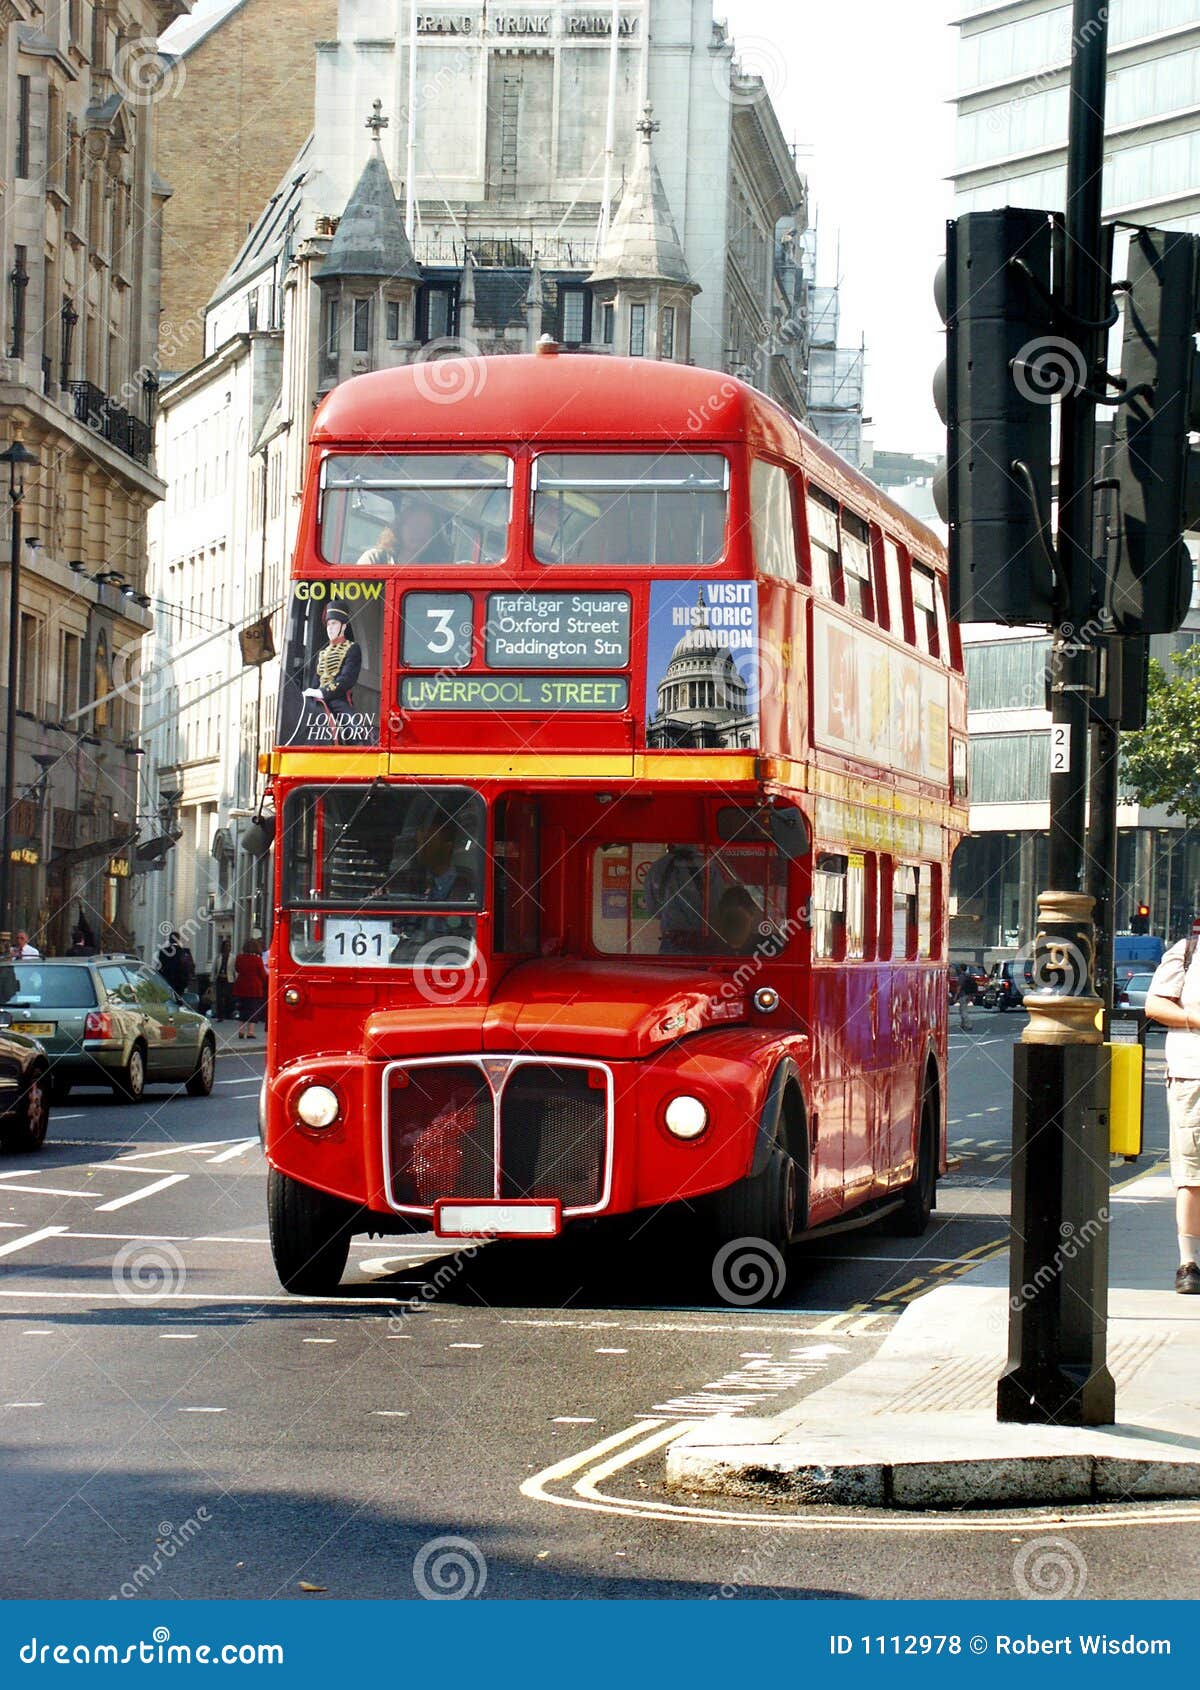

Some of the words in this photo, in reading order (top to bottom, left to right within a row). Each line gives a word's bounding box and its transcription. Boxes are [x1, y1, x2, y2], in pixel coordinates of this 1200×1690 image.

[494, 16, 551, 33] TRUNK
[568, 16, 638, 34] RAILWAY
[294, 582, 325, 600] GO
[330, 582, 383, 600] NOW
[707, 584, 752, 604] VISIT
[494, 597, 564, 617] Trafalgar
[571, 597, 629, 617] Square
[672, 606, 753, 626] HISTORIC
[427, 609, 456, 654] 3
[500, 618, 560, 633] Oxford
[567, 618, 620, 633] Street
[684, 629, 753, 648] LONDON
[495, 639, 587, 659] Paddington
[594, 640, 622, 655] Stn
[407, 682, 531, 702] LIVERPOOL
[541, 683, 622, 703] STREET
[306, 712, 375, 727] LONDON
[307, 727, 373, 740] HISTORY
[334, 932, 383, 956] 161
